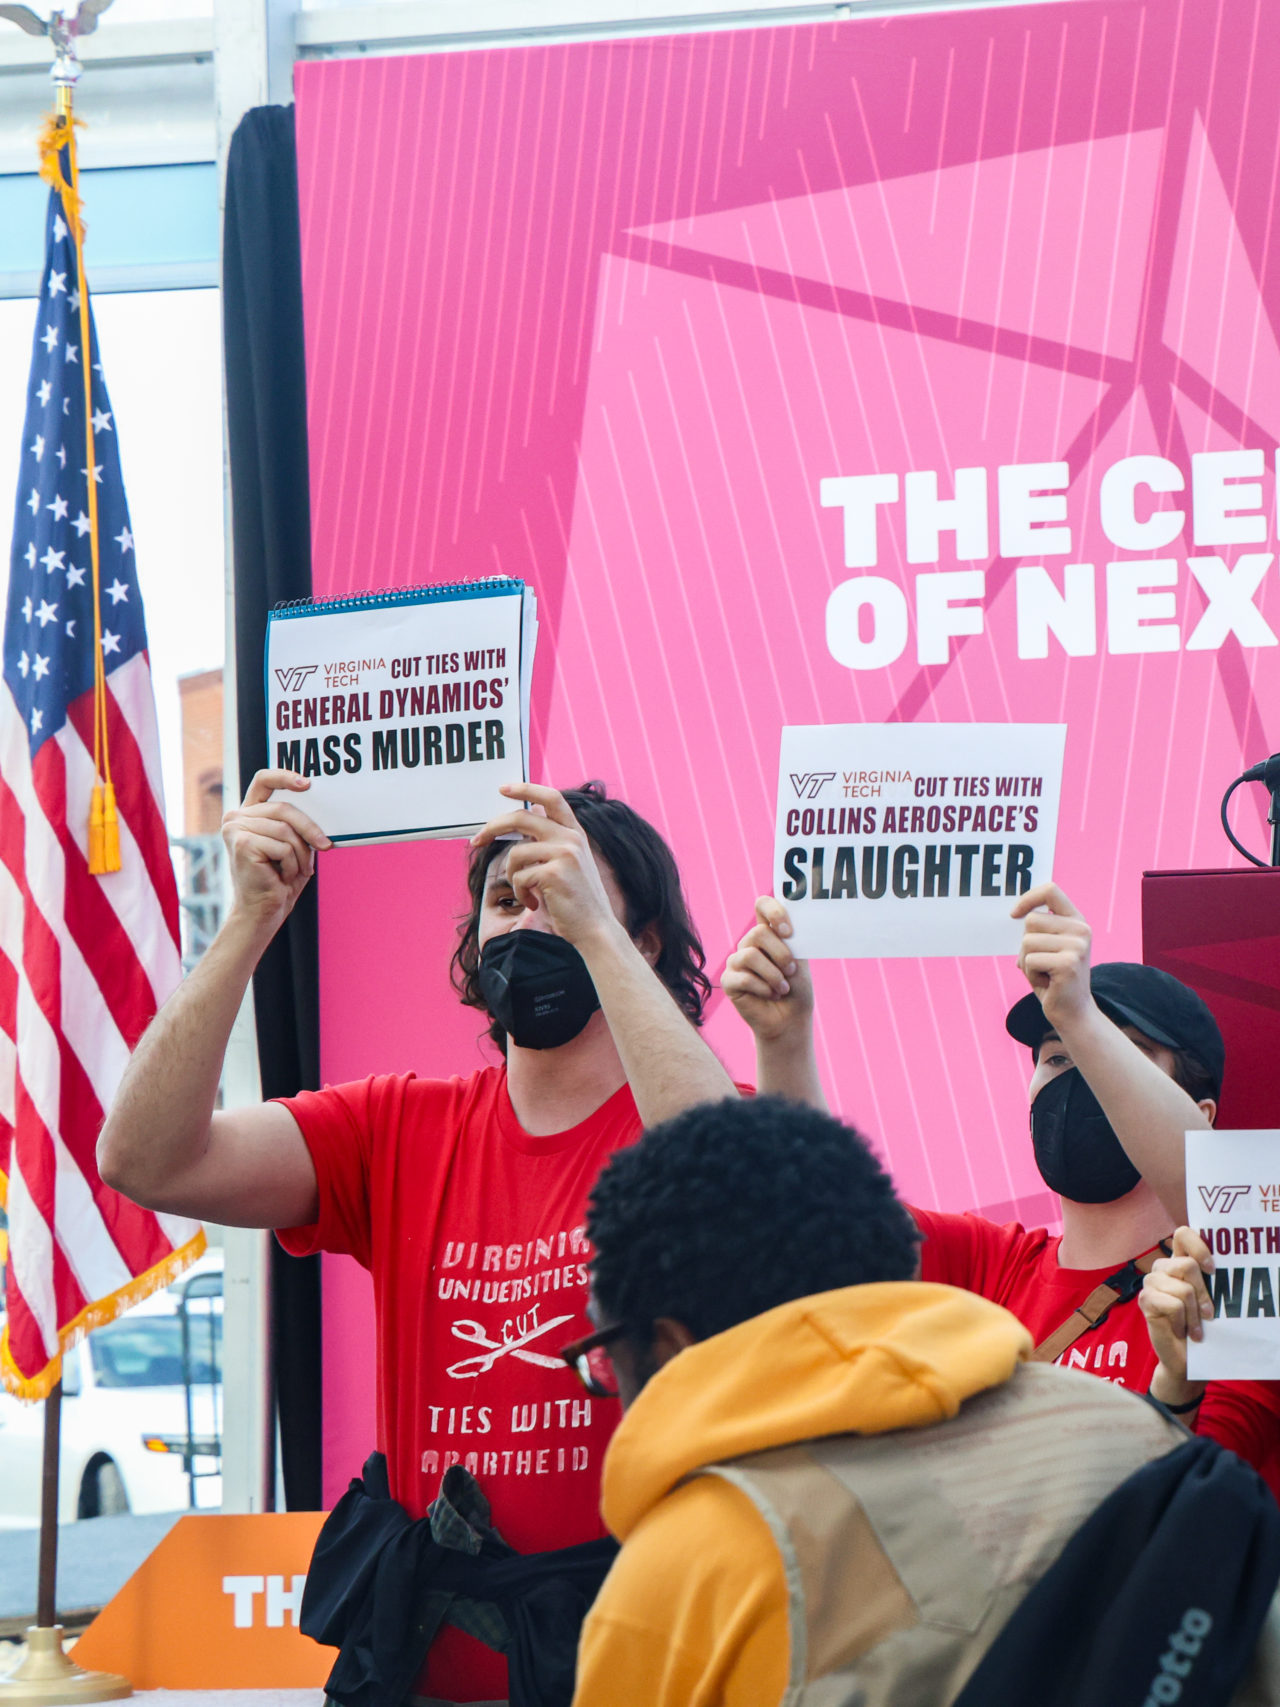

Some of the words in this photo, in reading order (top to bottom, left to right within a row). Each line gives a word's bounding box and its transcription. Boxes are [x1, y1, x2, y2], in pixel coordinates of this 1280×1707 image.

[819, 461, 1072, 568] THE
[825, 570, 986, 670] OF
[275, 664, 318, 692] VT
[324, 657, 387, 675] VIRGINIA
[390, 656, 422, 679] CUT
[425, 652, 460, 675] TIES
[464, 648, 507, 671] WITH
[324, 674, 360, 689] TECH
[276, 691, 373, 731] GENERAL
[276, 732, 363, 778] MASS
[372, 719, 506, 772] MURDER
[789, 772, 837, 799] VT
[842, 770, 913, 784] VIRGINIA
[914, 776, 948, 798] CUT
[953, 776, 990, 797] TIES
[995, 776, 1043, 798] WITH
[842, 785, 882, 798] TECH
[786, 806, 877, 837] COLLINS
[882, 804, 1039, 834] AEROSPACE'S
[782, 844, 1035, 901] SLAUGHTER
[1197, 1185, 1252, 1214] VT
[437, 1262, 589, 1304] UNIVERSITIES
[500, 1302, 541, 1345] CUT
[428, 1405, 493, 1435] TIES
[511, 1399, 592, 1433] WITH
